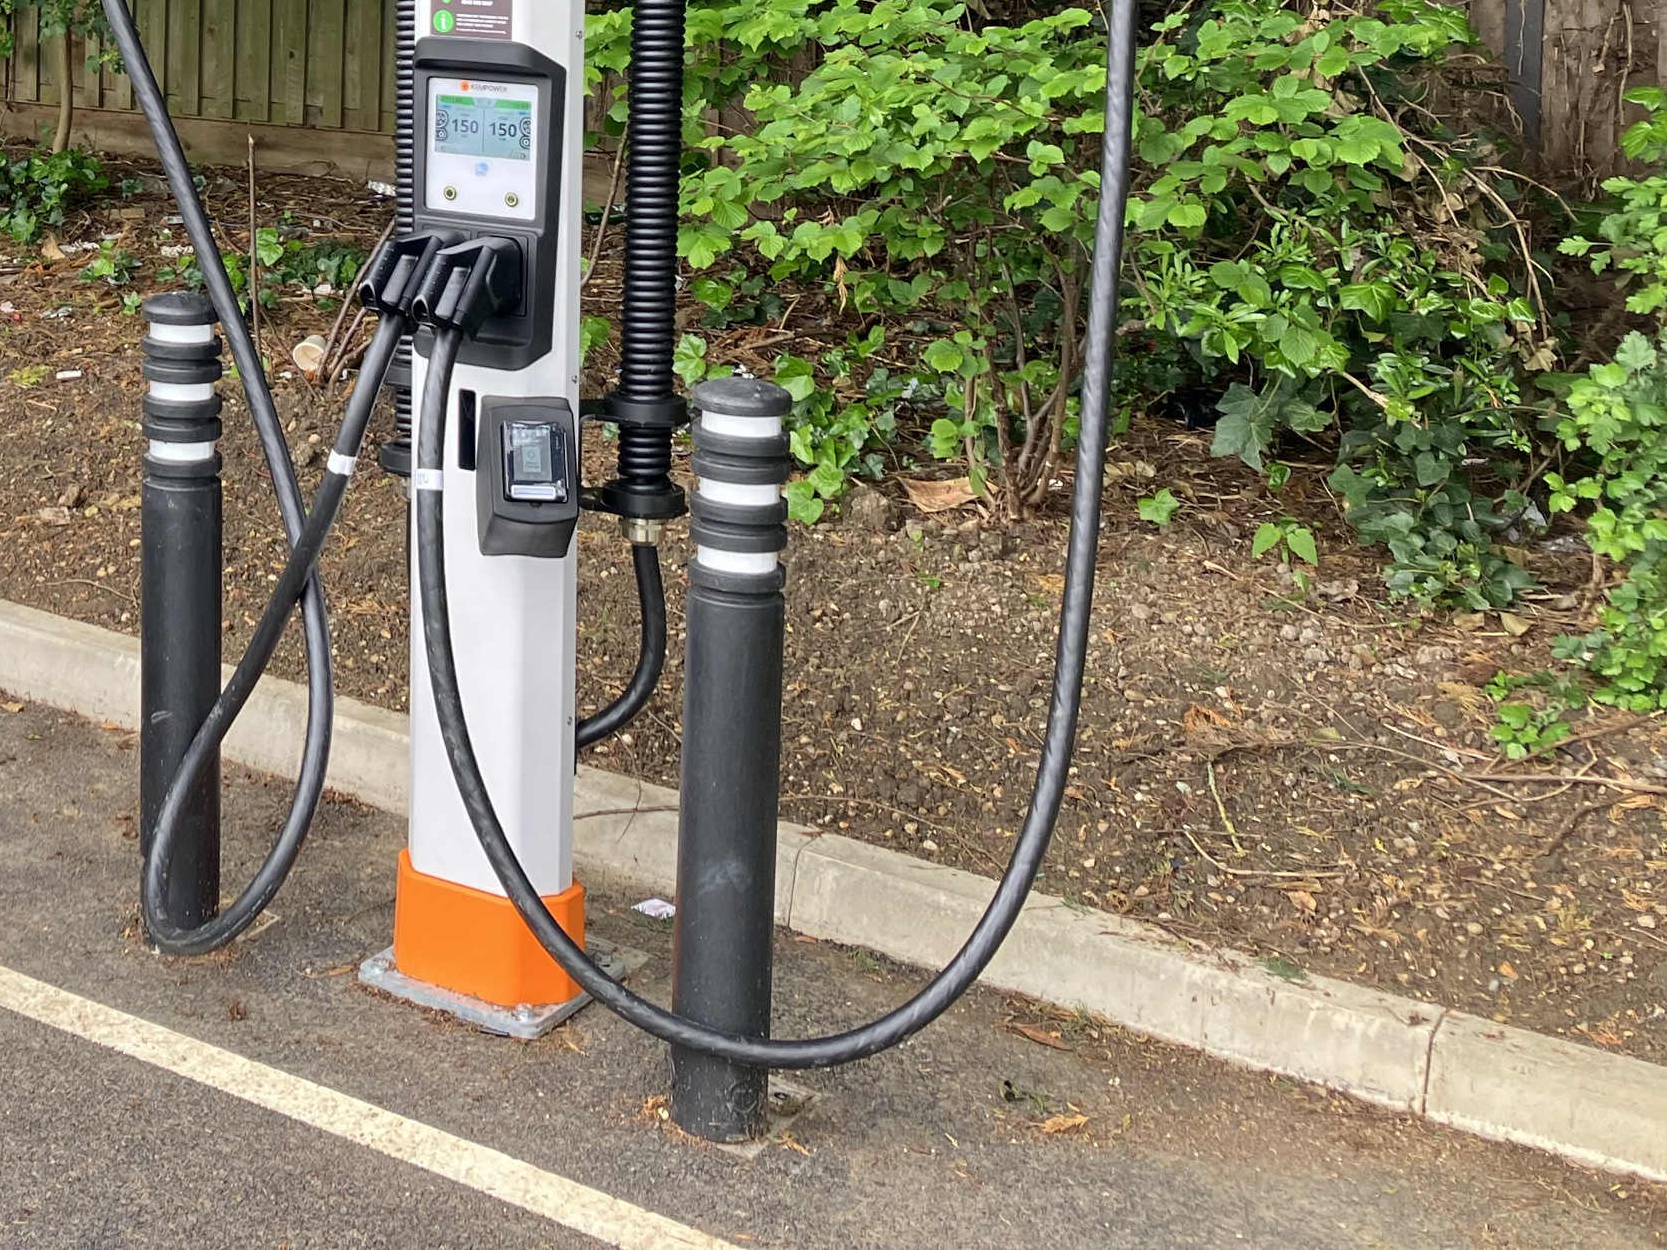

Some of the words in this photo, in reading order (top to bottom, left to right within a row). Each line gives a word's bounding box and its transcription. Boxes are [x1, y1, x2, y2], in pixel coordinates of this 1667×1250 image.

[470, 84, 508, 92] KEMPOWER
[452, 118, 479, 134] 150
[489, 122, 517, 137] 150
